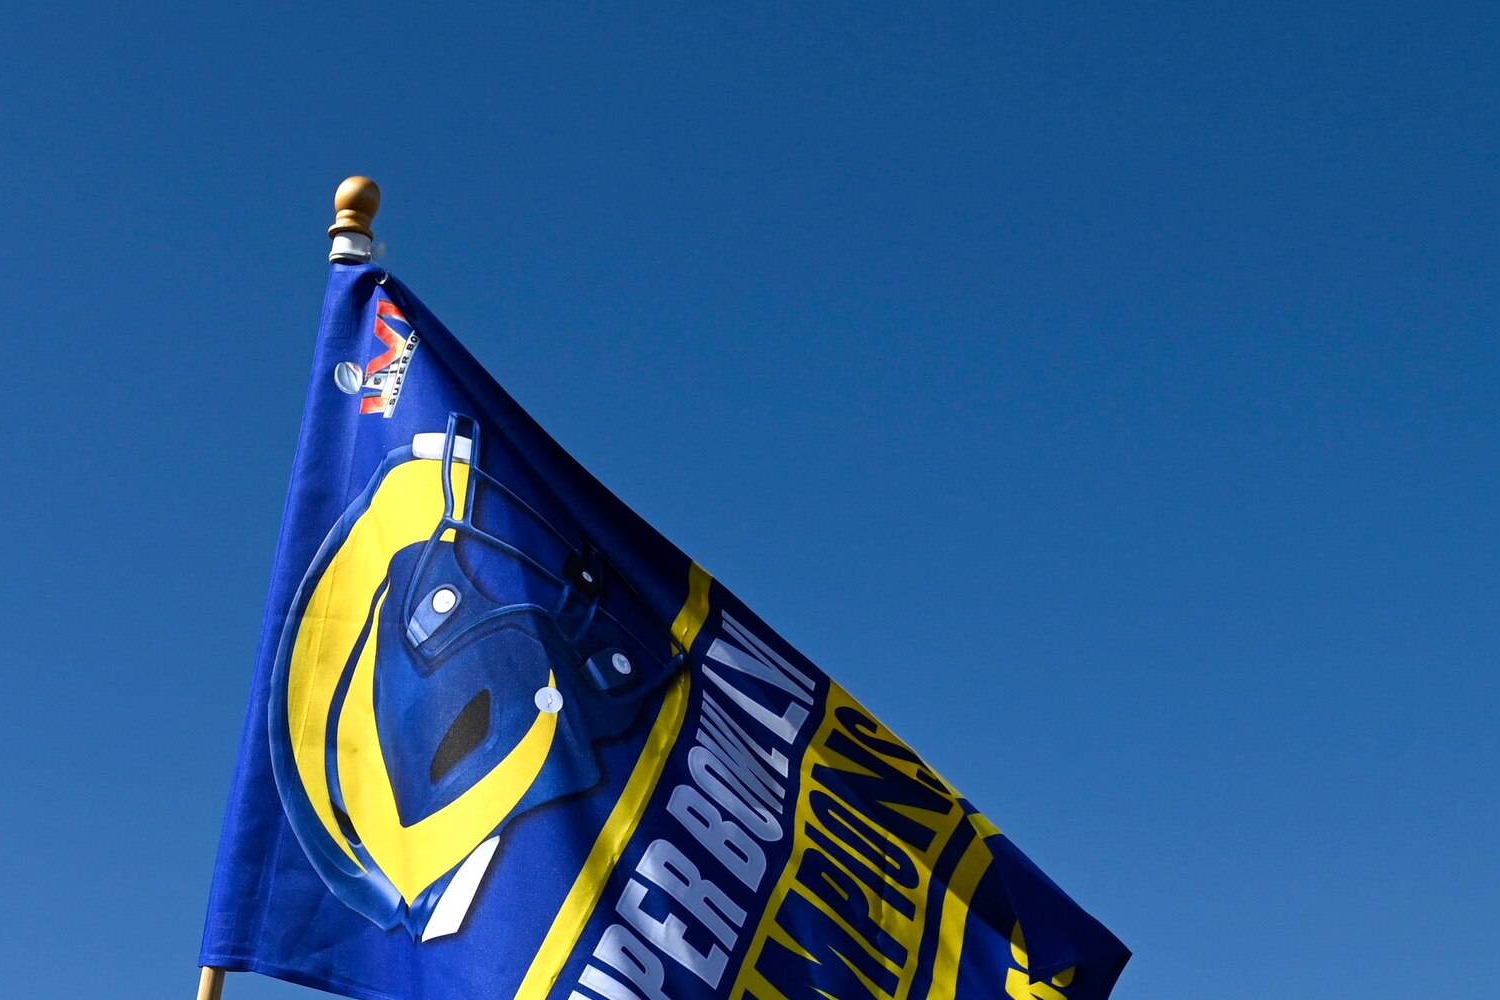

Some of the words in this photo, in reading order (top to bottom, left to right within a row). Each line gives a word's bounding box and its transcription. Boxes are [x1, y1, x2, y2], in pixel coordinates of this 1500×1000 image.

[389, 356, 409, 406] SUPER
[701, 609, 816, 745] LVI
[666, 689, 789, 893] BOWL
